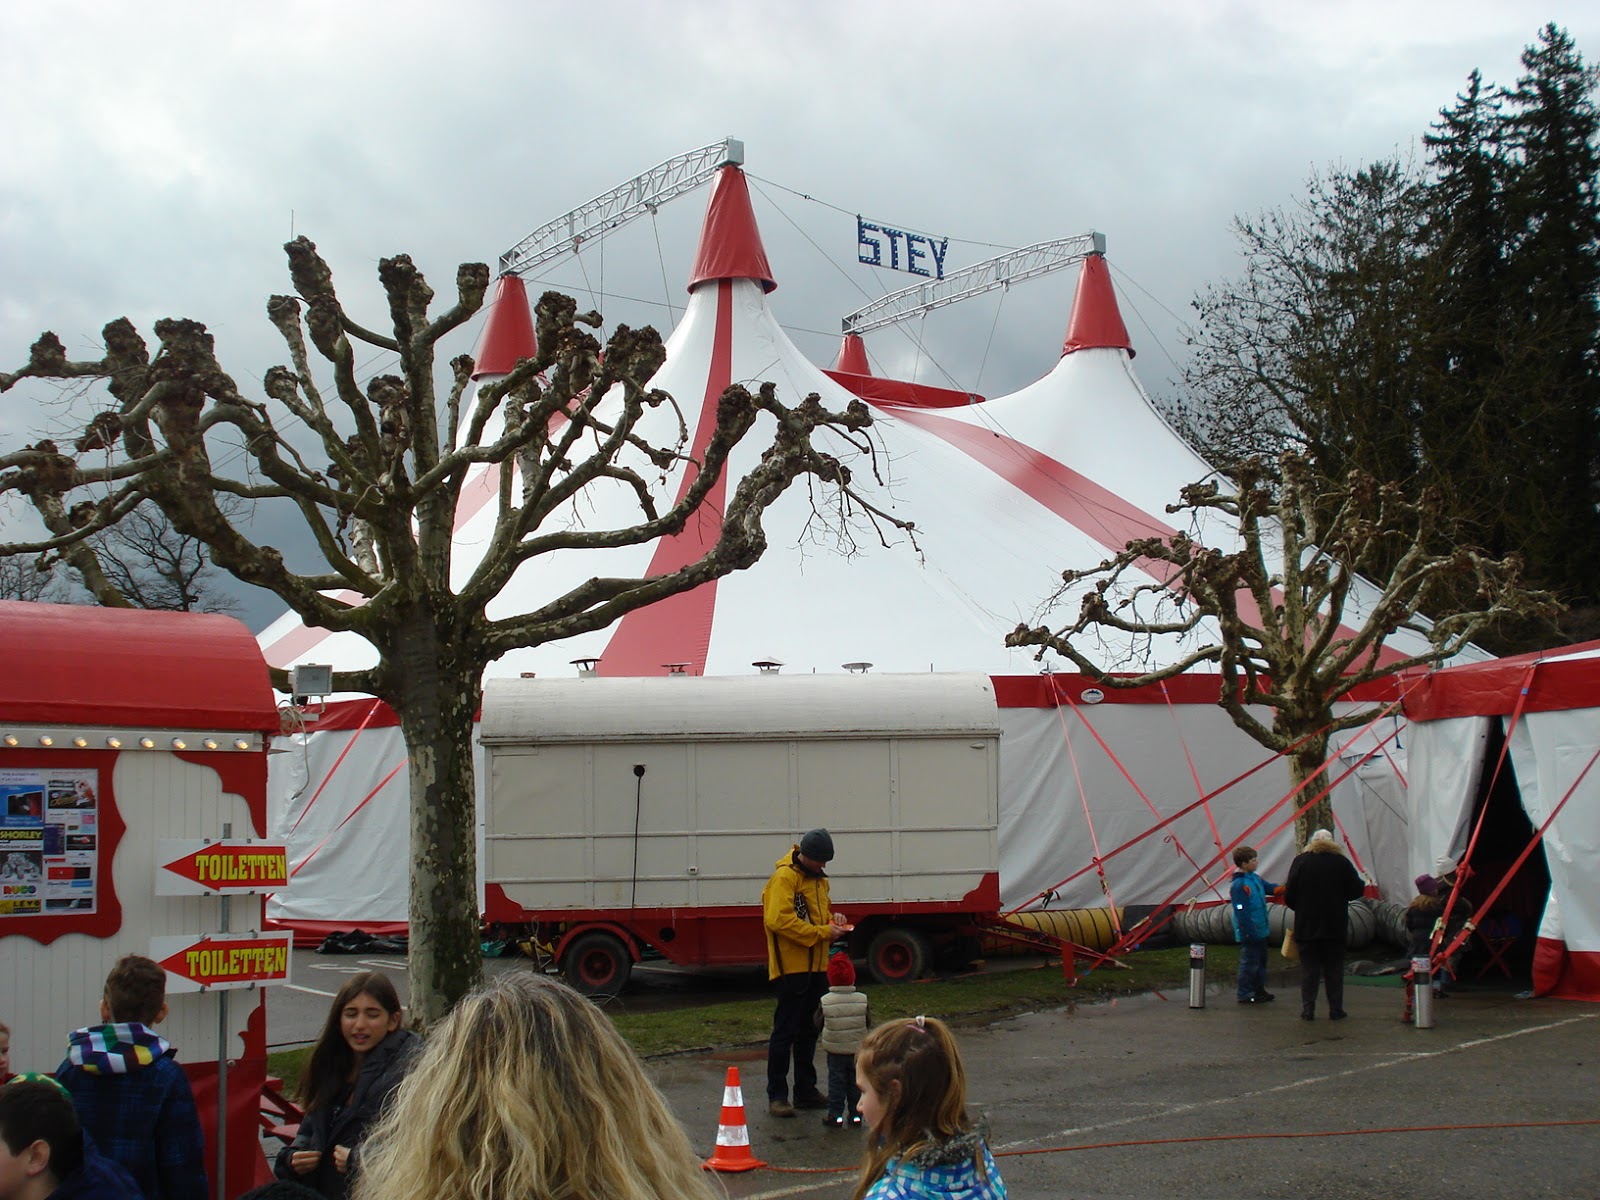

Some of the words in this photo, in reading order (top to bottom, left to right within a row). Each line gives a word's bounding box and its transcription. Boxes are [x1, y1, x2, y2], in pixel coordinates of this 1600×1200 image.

[858, 216, 948, 280] STEY
[0, 830, 42, 839] SHORLEY
[195, 854, 287, 881] TOILETTEN
[186, 947, 287, 977] TOILETTEN
